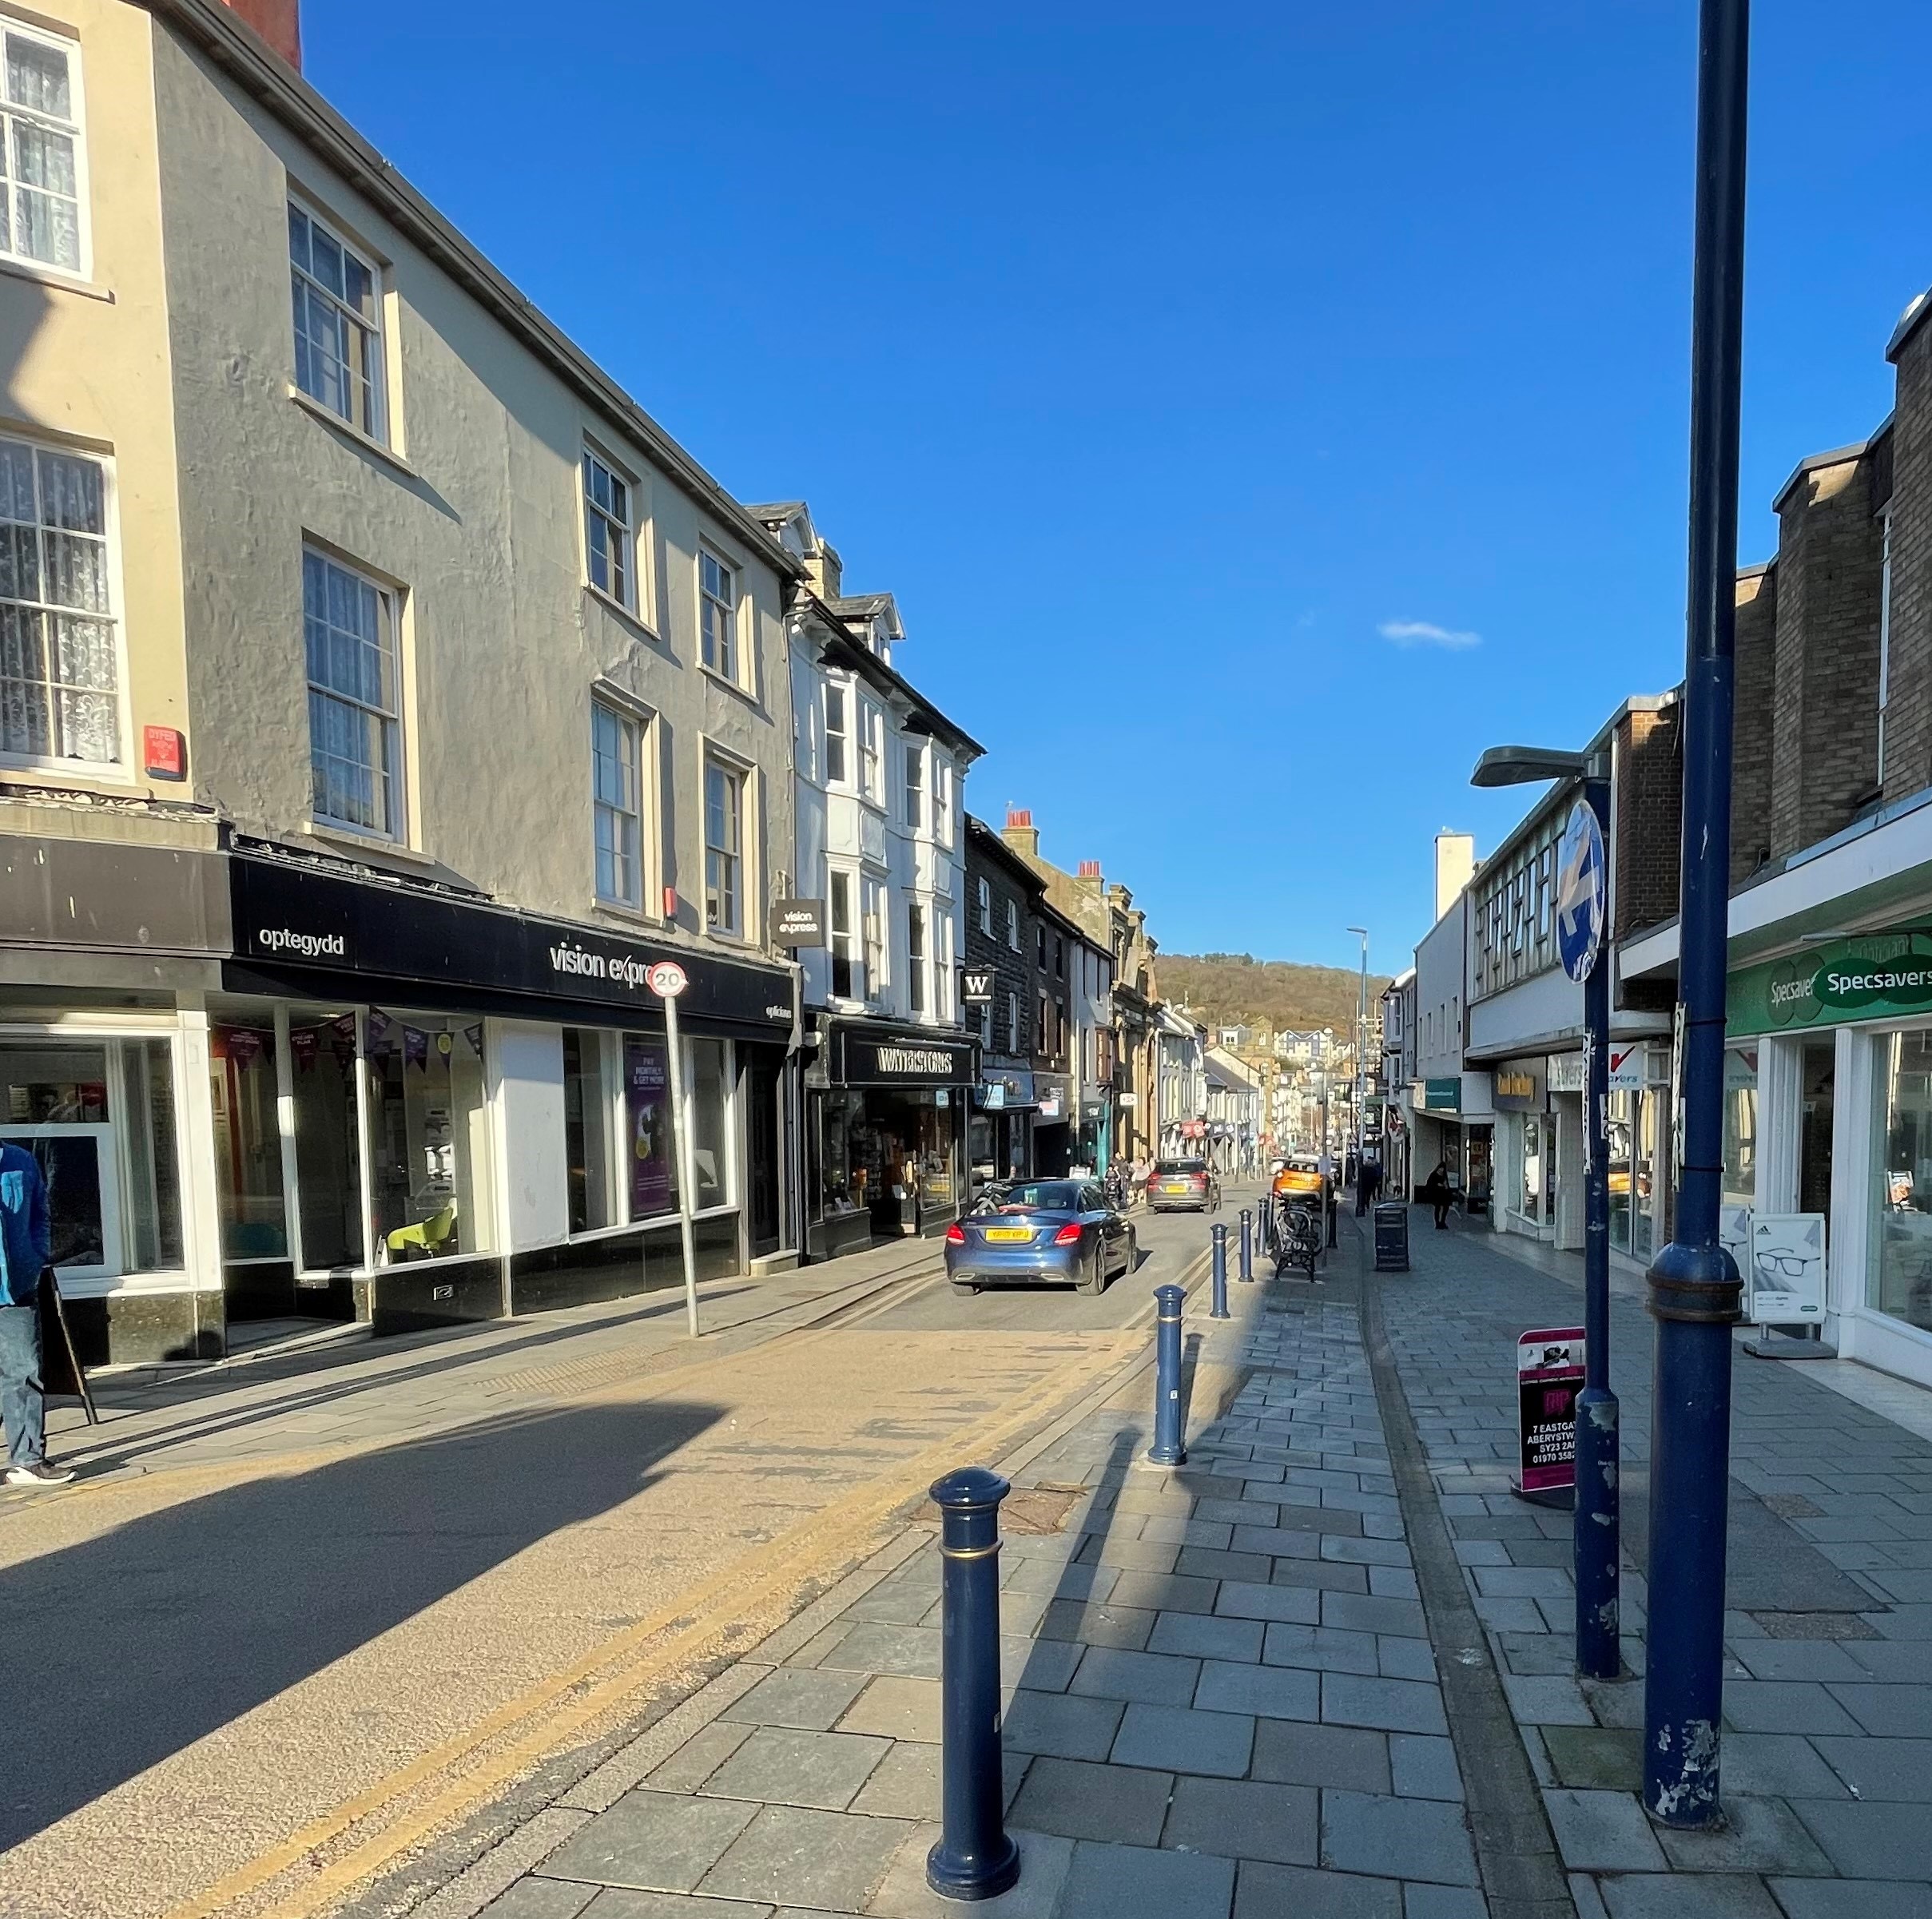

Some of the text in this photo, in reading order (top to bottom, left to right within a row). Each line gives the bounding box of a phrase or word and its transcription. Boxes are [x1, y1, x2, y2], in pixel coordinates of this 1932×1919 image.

[784, 911, 813, 922] vision
[778, 922, 818, 935] express
[259, 928, 344, 957] optegydd
[550, 941, 653, 990] vision expr
[656, 972, 679, 987] 20
[964, 976, 988, 994] W
[1827, 971, 1932, 995] Specsavers
[1771, 978, 1813, 1008] Specsaver
[1608, 1074, 1638, 1083] avers
[1540, 1421, 1576, 1432] EASTGA
[1527, 1432, 1575, 1444] ABERYSTW
[1533, 1452, 1575, 1463] 01970 358
